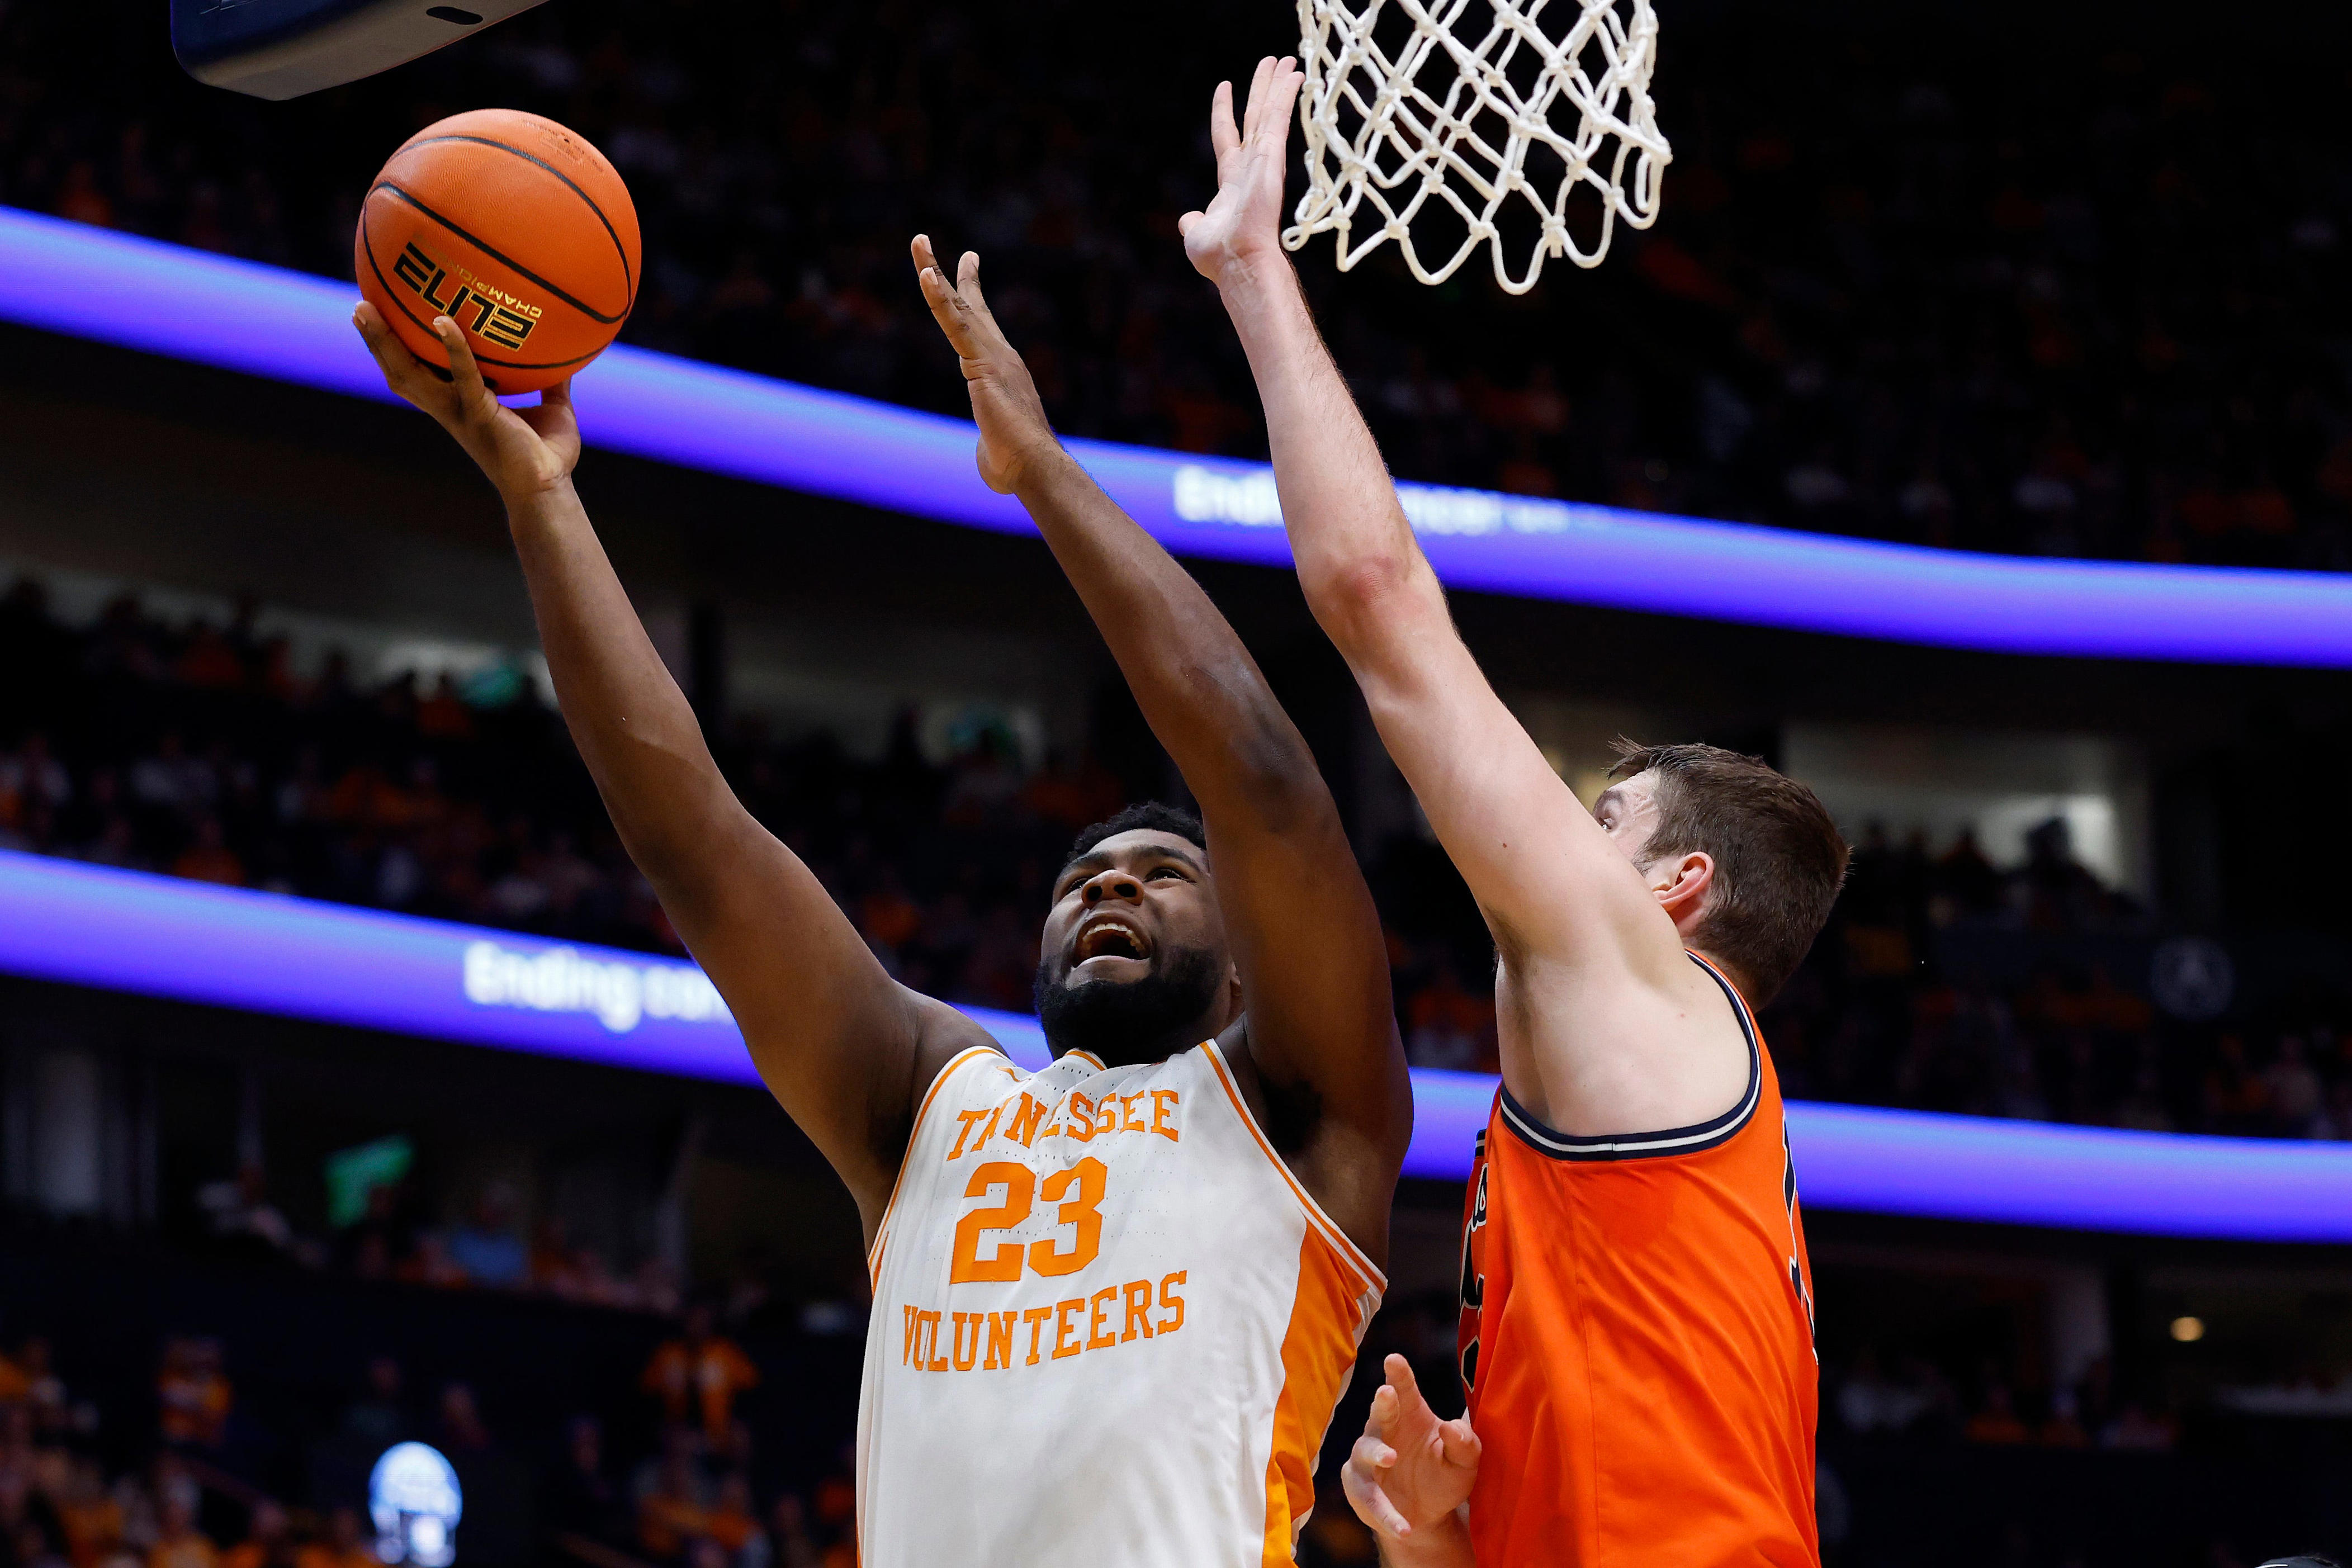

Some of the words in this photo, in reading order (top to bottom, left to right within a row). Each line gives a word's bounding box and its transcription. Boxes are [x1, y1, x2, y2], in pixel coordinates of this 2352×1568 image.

[393, 241, 537, 352] ELITE
[949, 1156, 1108, 1285] 23
[903, 1270, 1187, 1372] VOLUNTEERS
